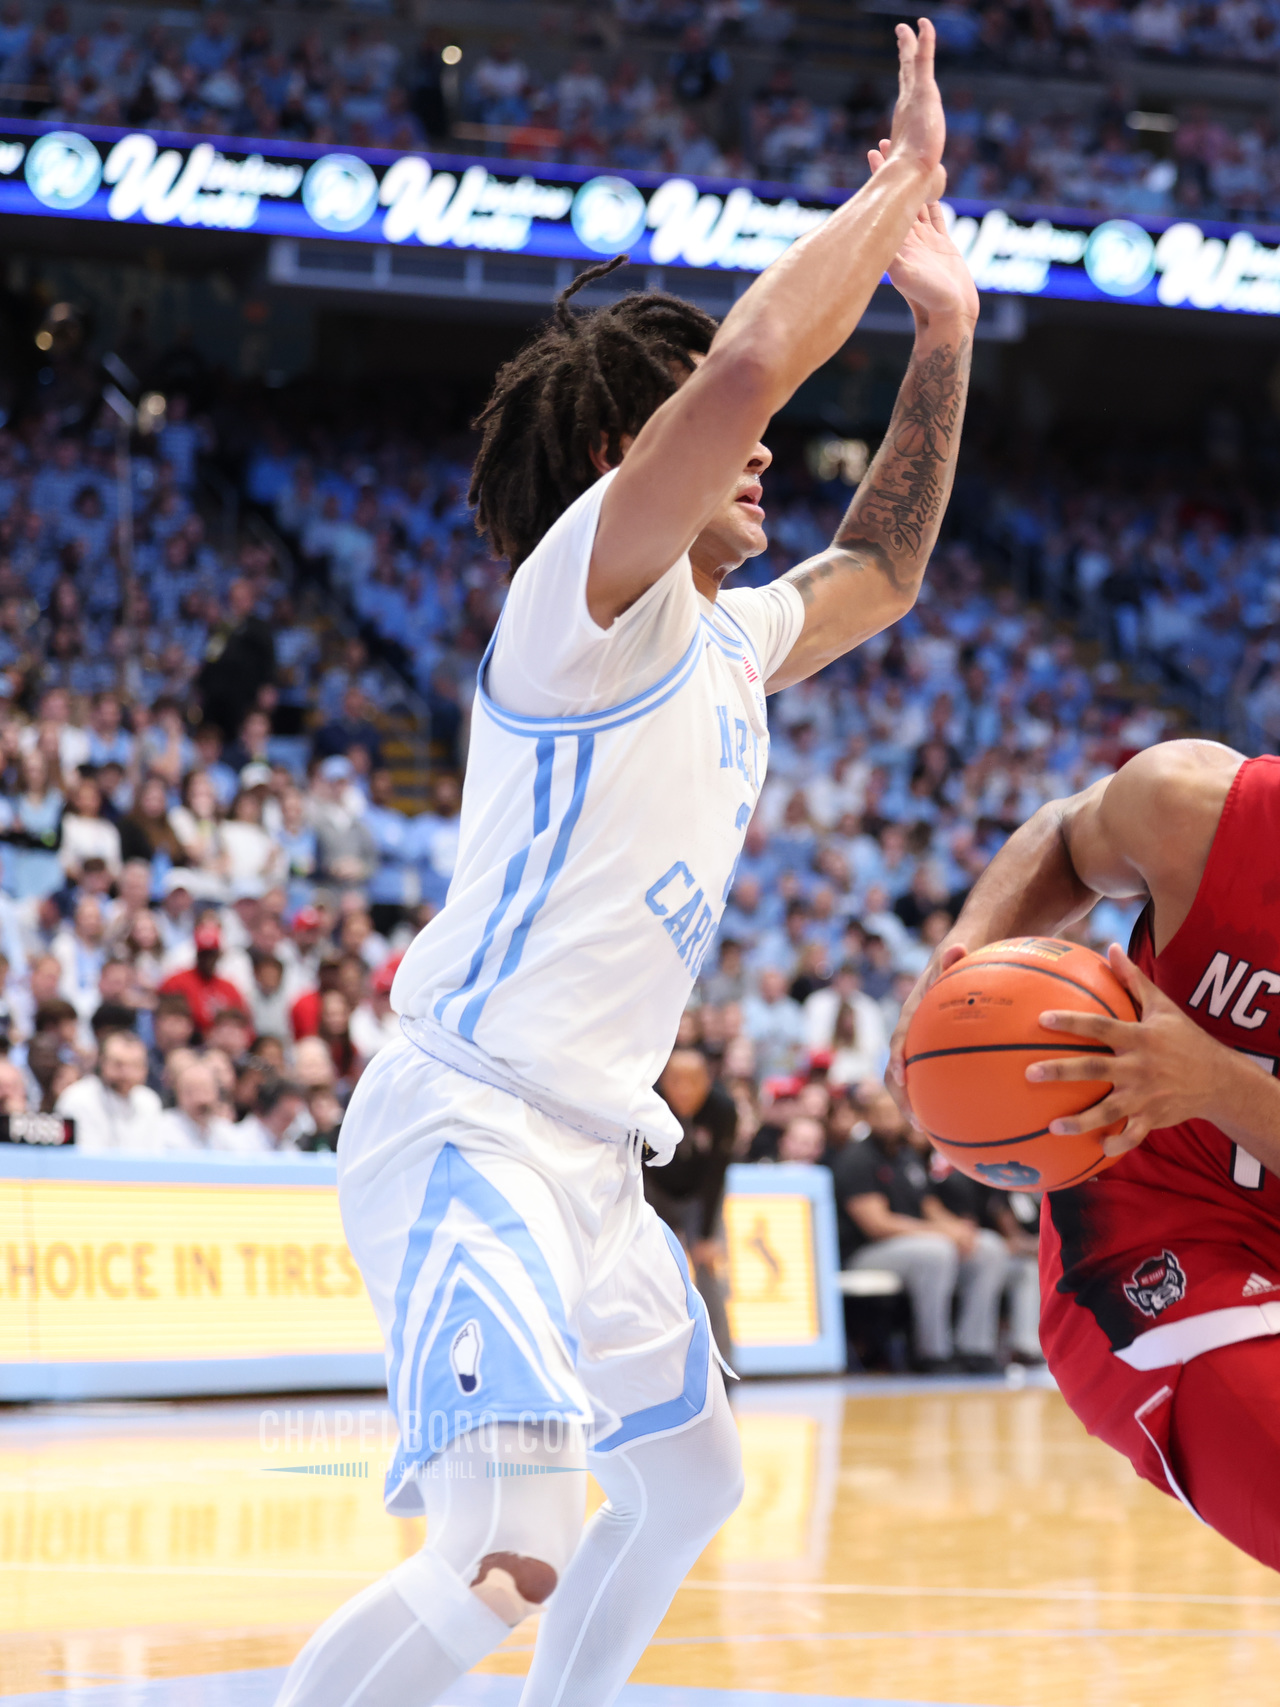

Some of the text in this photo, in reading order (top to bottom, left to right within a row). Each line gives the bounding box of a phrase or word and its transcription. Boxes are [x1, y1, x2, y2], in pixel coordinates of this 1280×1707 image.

[0, 1241, 365, 1300] HOICE IN TIRES
